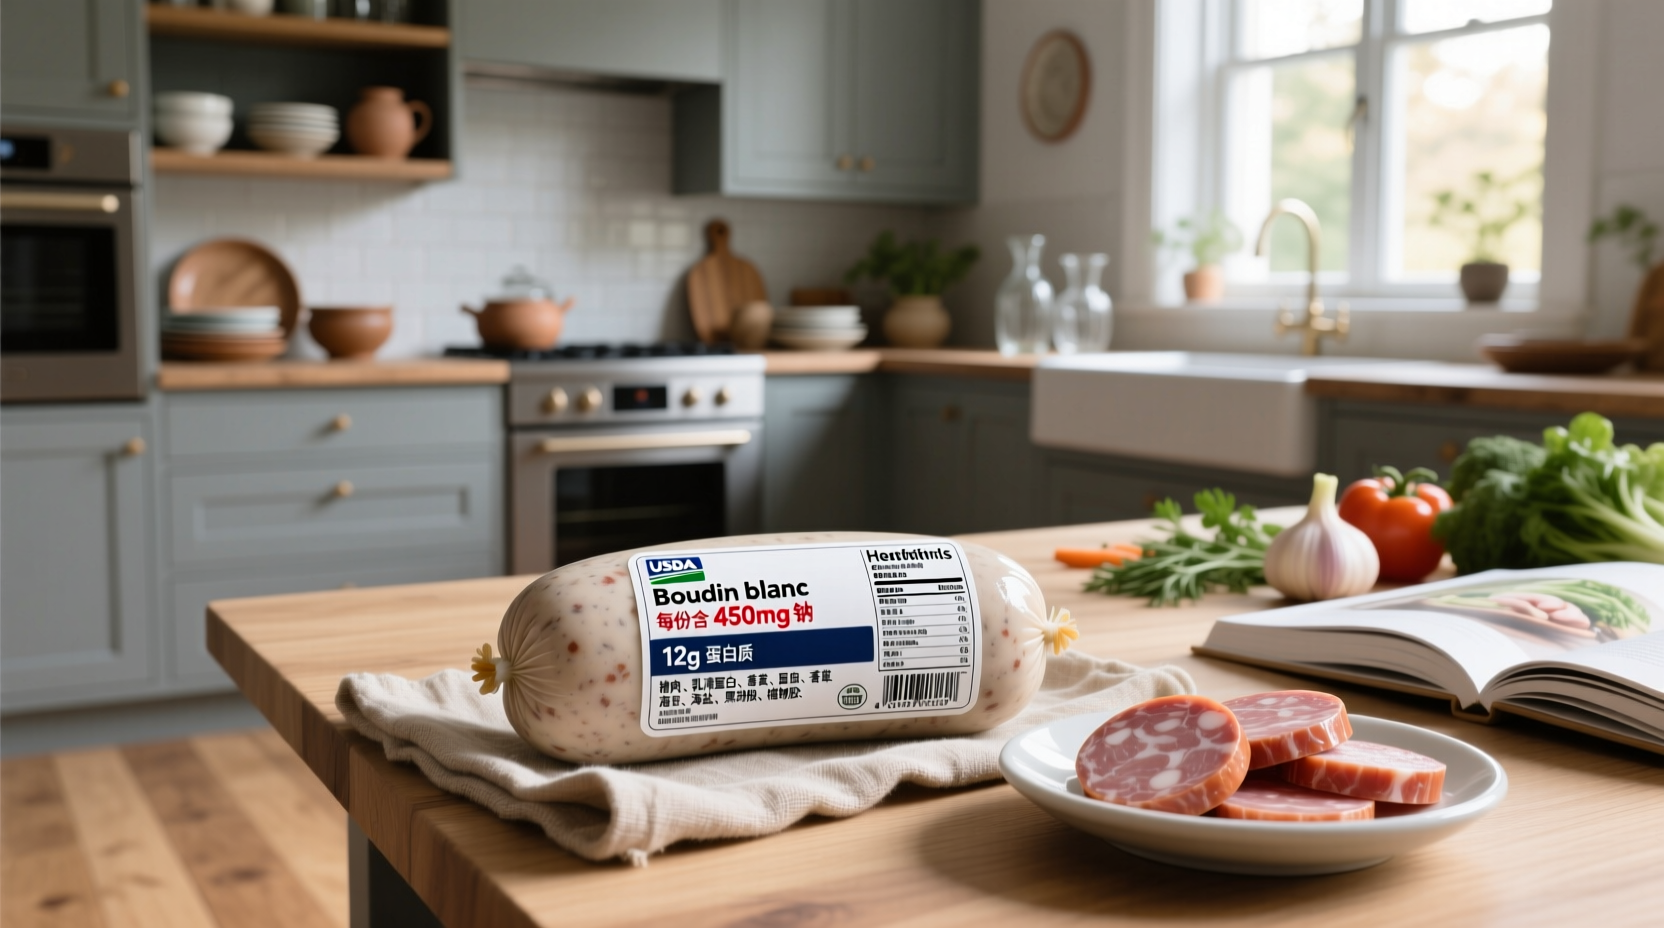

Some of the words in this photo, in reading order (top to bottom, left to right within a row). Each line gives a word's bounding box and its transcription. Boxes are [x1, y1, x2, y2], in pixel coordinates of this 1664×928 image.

[648, 559, 698, 573] USDA
[653, 583, 739, 606] Boudin
[744, 580, 809, 600] blanc
[656, 610, 709, 631] 每份含
[714, 605, 790, 629] 450mg
[793, 601, 813, 623] 钠
[662, 645, 700, 670] 12g
[706, 644, 753, 664] 蛋白质
